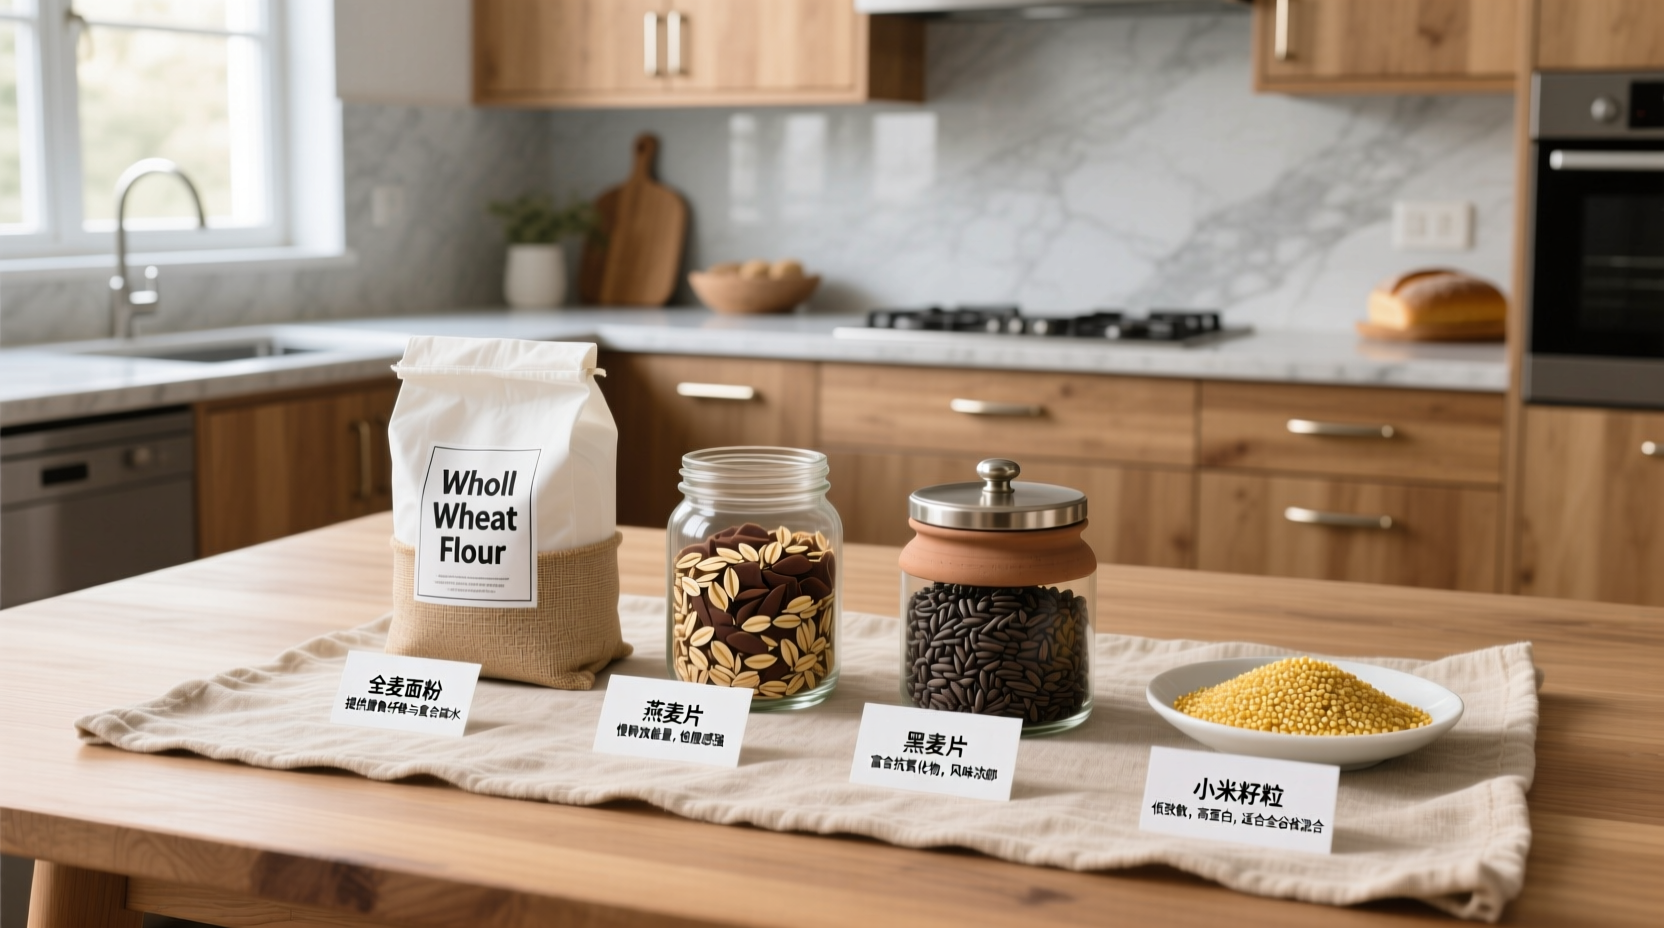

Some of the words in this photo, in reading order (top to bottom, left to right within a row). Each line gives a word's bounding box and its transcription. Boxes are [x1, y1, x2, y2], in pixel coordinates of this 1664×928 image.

[443, 469, 517, 497] Wholl
[433, 501, 518, 531] Wheat
[440, 536, 507, 565] Flour
[368, 675, 442, 701] 全麦面粉
[643, 700, 703, 727] 燕麦片
[903, 731, 967, 757] 黑麦片
[1193, 778, 1284, 807] 小米籽粒
